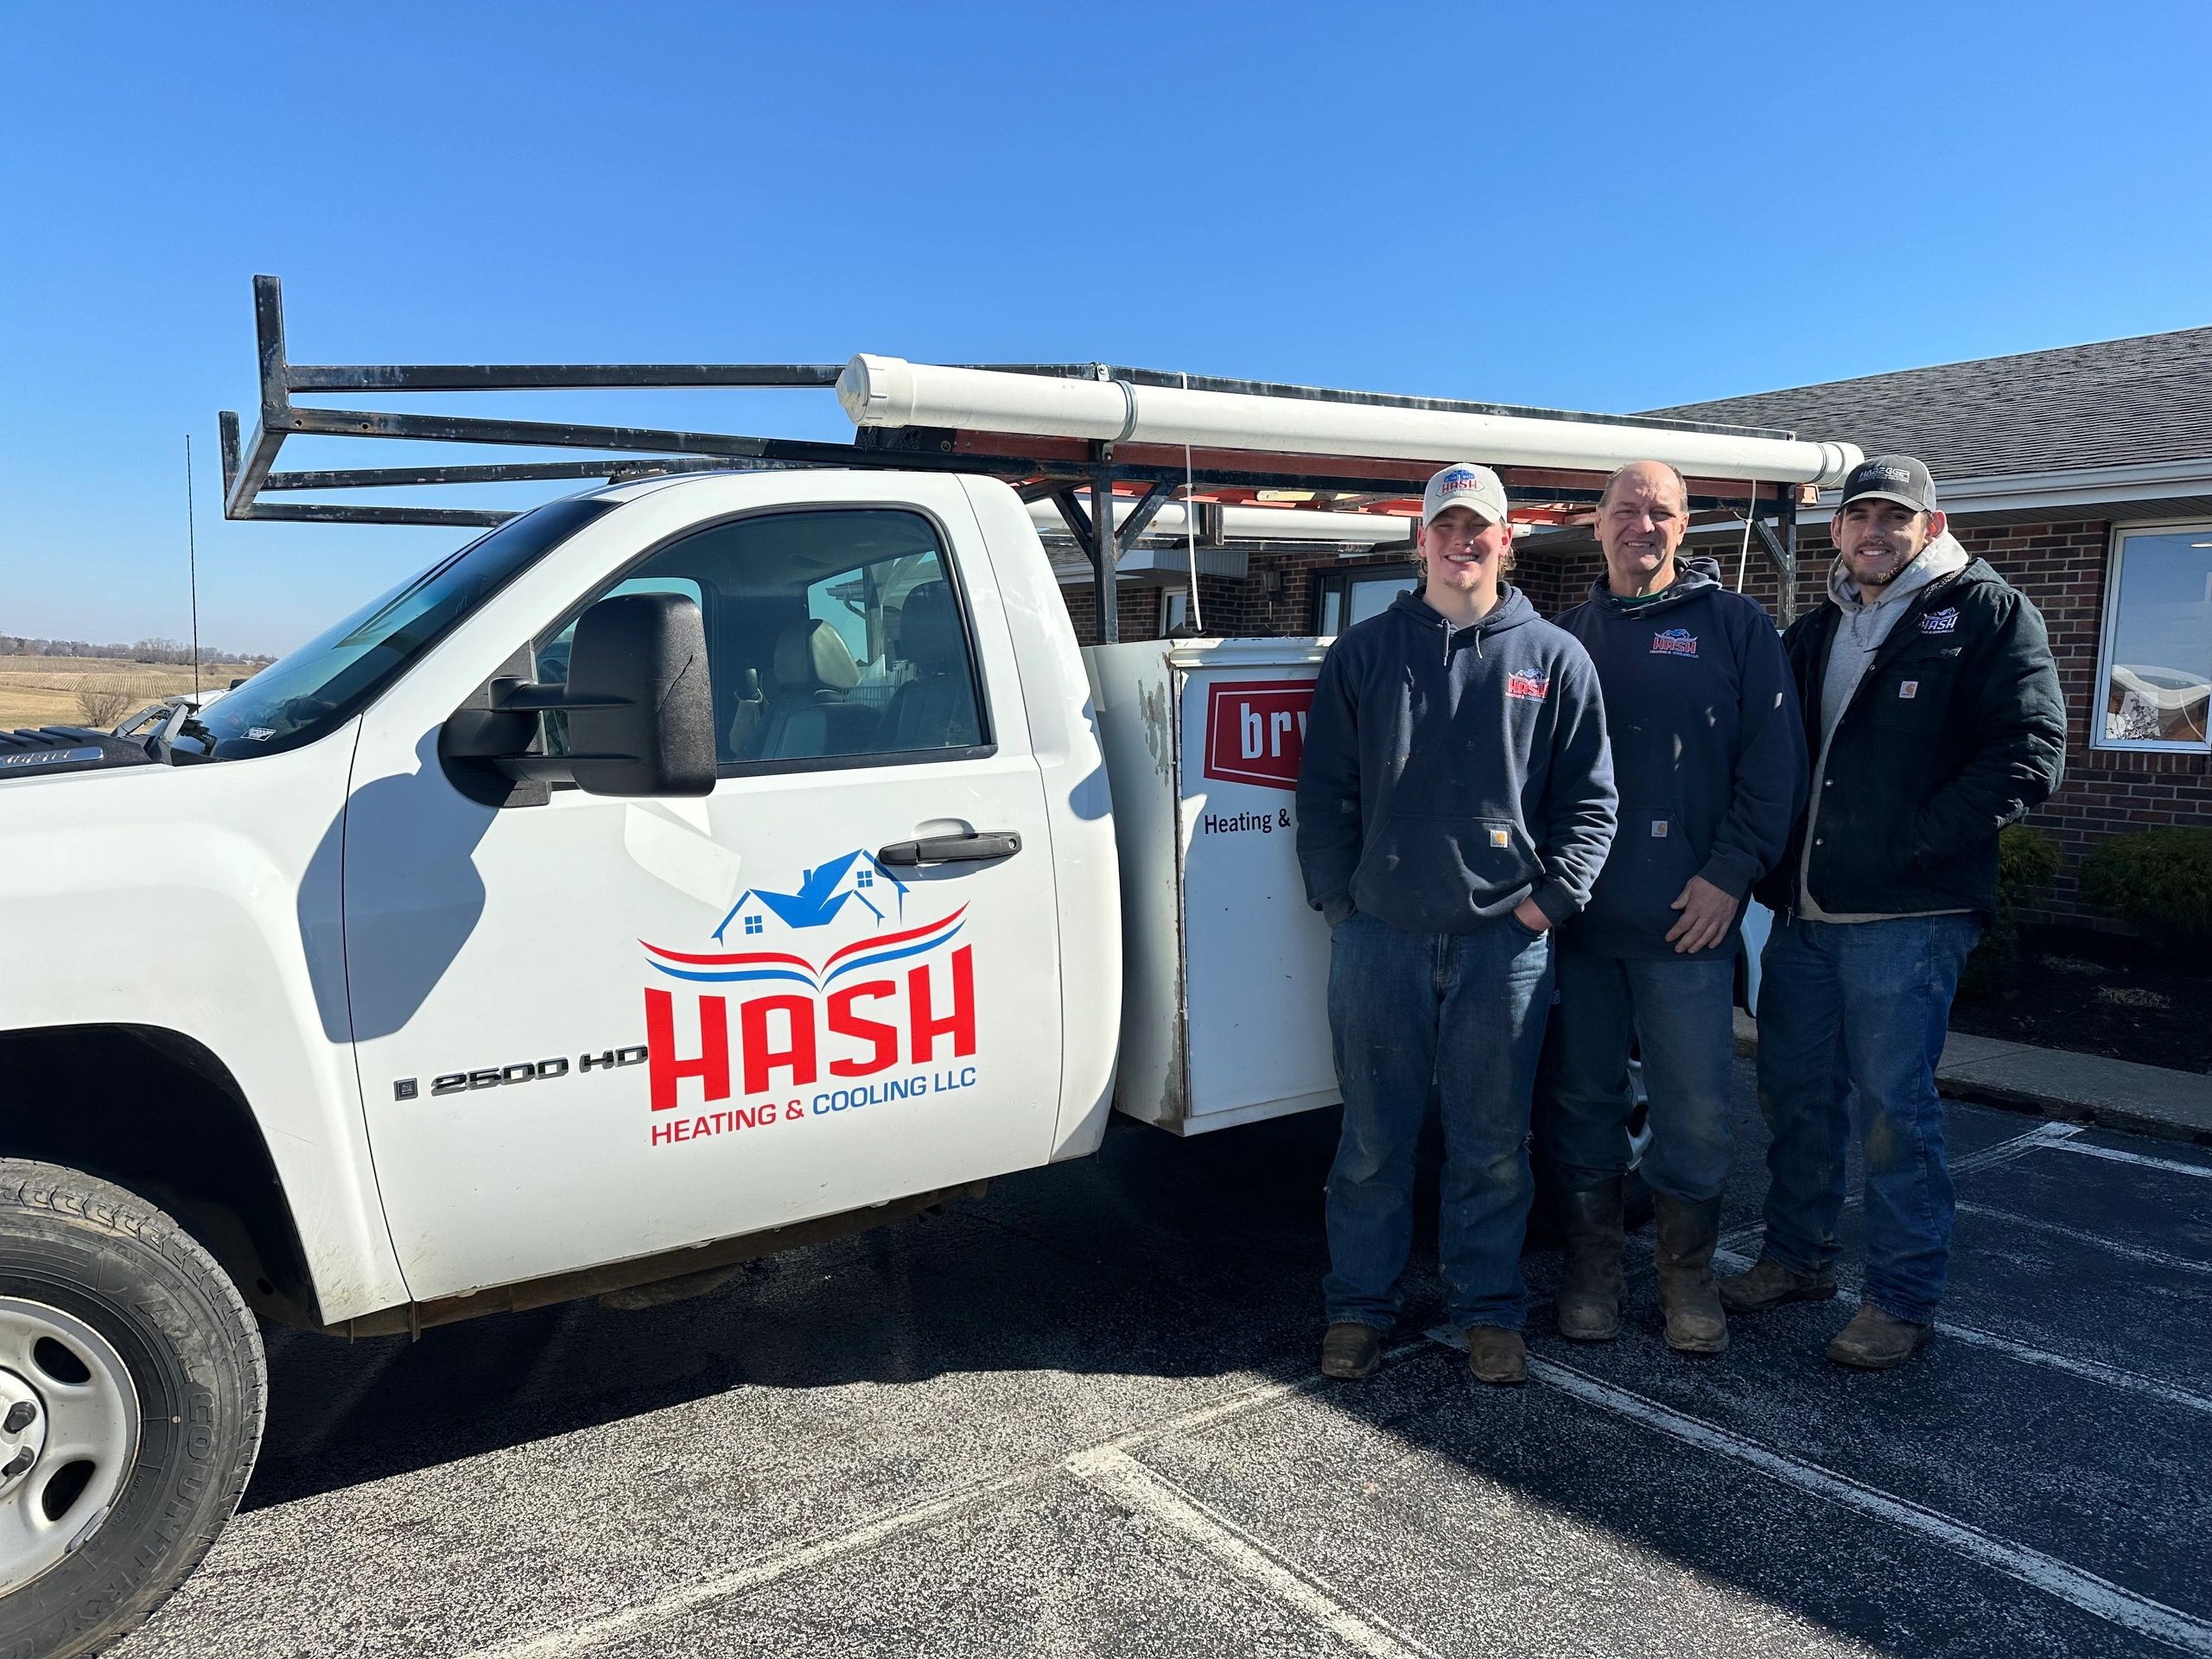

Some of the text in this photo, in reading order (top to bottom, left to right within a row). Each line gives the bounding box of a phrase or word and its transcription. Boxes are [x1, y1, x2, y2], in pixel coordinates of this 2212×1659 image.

[1441, 480, 1478, 493] HASH
[1921, 615, 1958, 630] HASH
[1652, 637, 1697, 653] HASH
[1508, 677, 1548, 698] HASH
[1205, 808, 1291, 835] Heating &
[645, 944, 976, 1112] HASH
[430, 1044, 649, 1097] 2500 HD
[651, 1067, 977, 1147] HEATING & COOLING LLC
